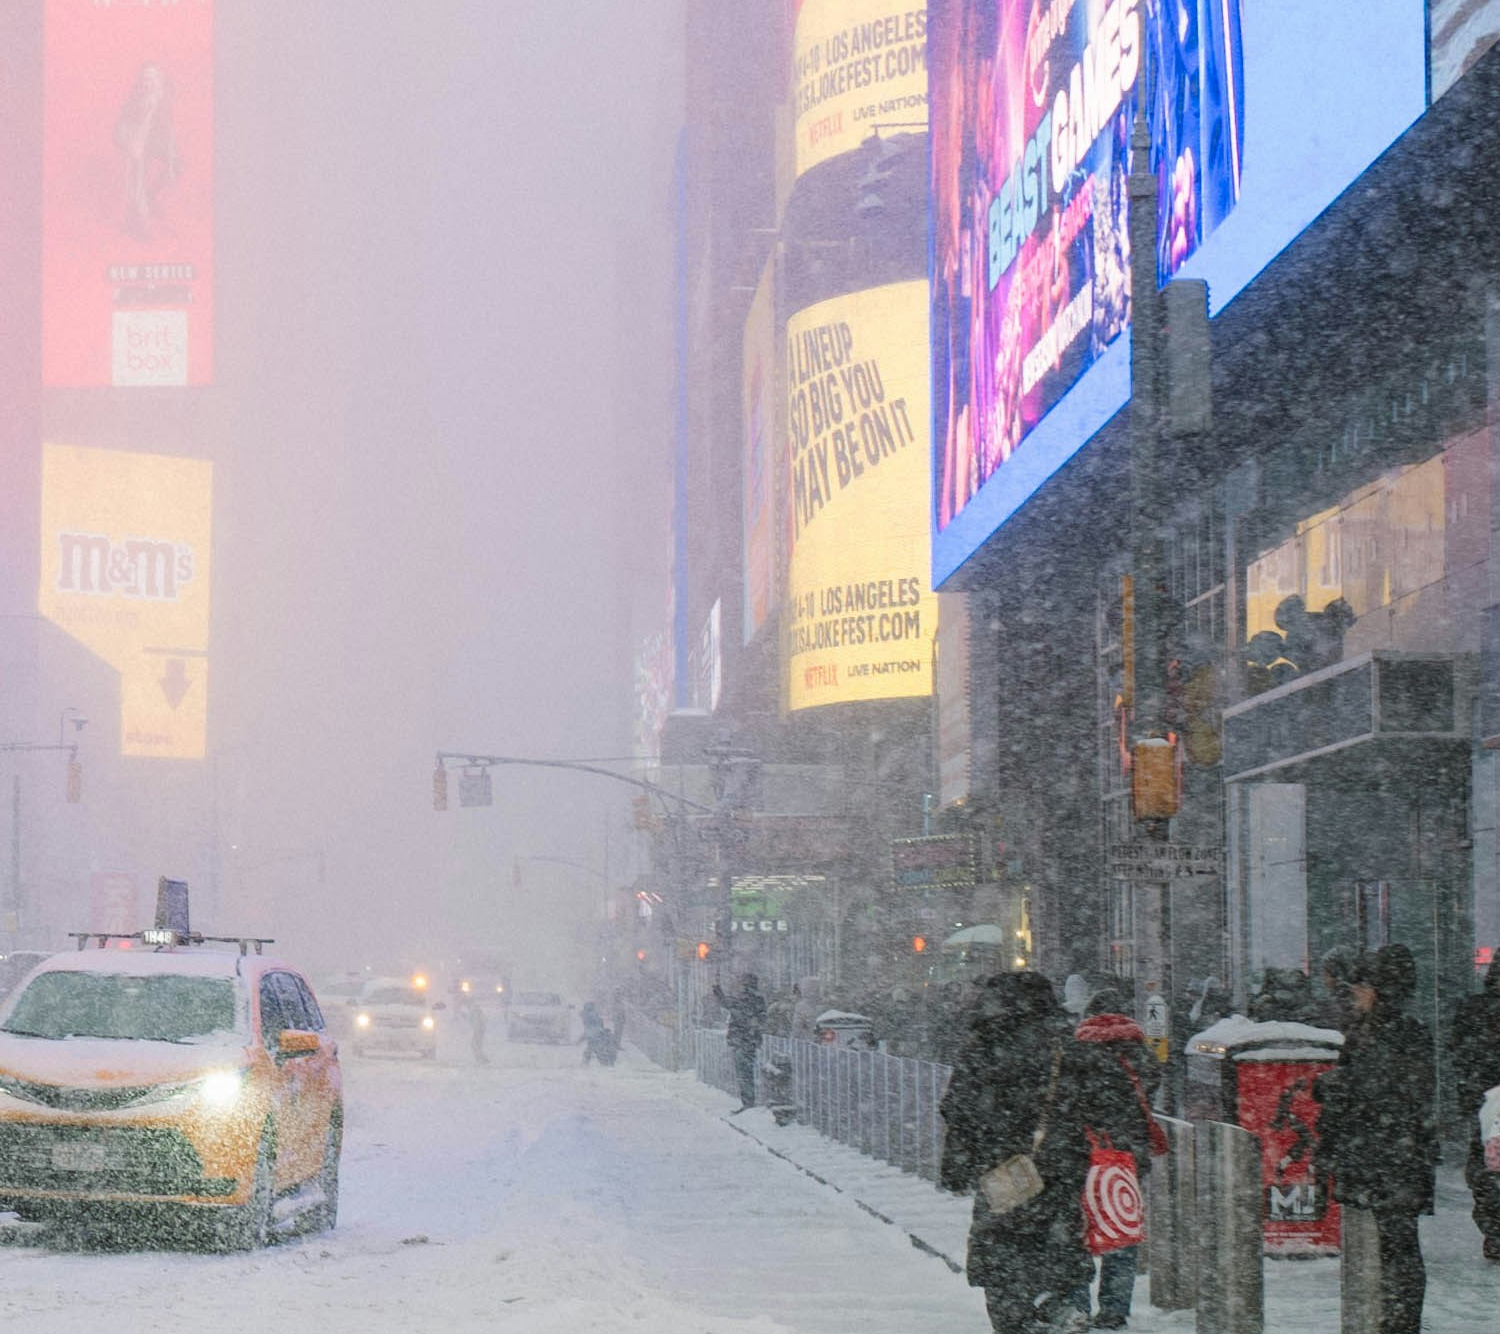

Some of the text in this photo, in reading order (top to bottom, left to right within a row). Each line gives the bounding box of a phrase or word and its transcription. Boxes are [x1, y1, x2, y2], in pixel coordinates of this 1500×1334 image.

[850, 9, 927, 57] ANGELES
[988, 112, 1052, 292] BEAST
[796, 321, 854, 385] LINEUP
[809, 371, 844, 440] BIG
[839, 359, 885, 415] YOU
[792, 397, 916, 544] MAY BE ON IT
[820, 586, 843, 617] LOS
[845, 577, 921, 613] ANGELES
